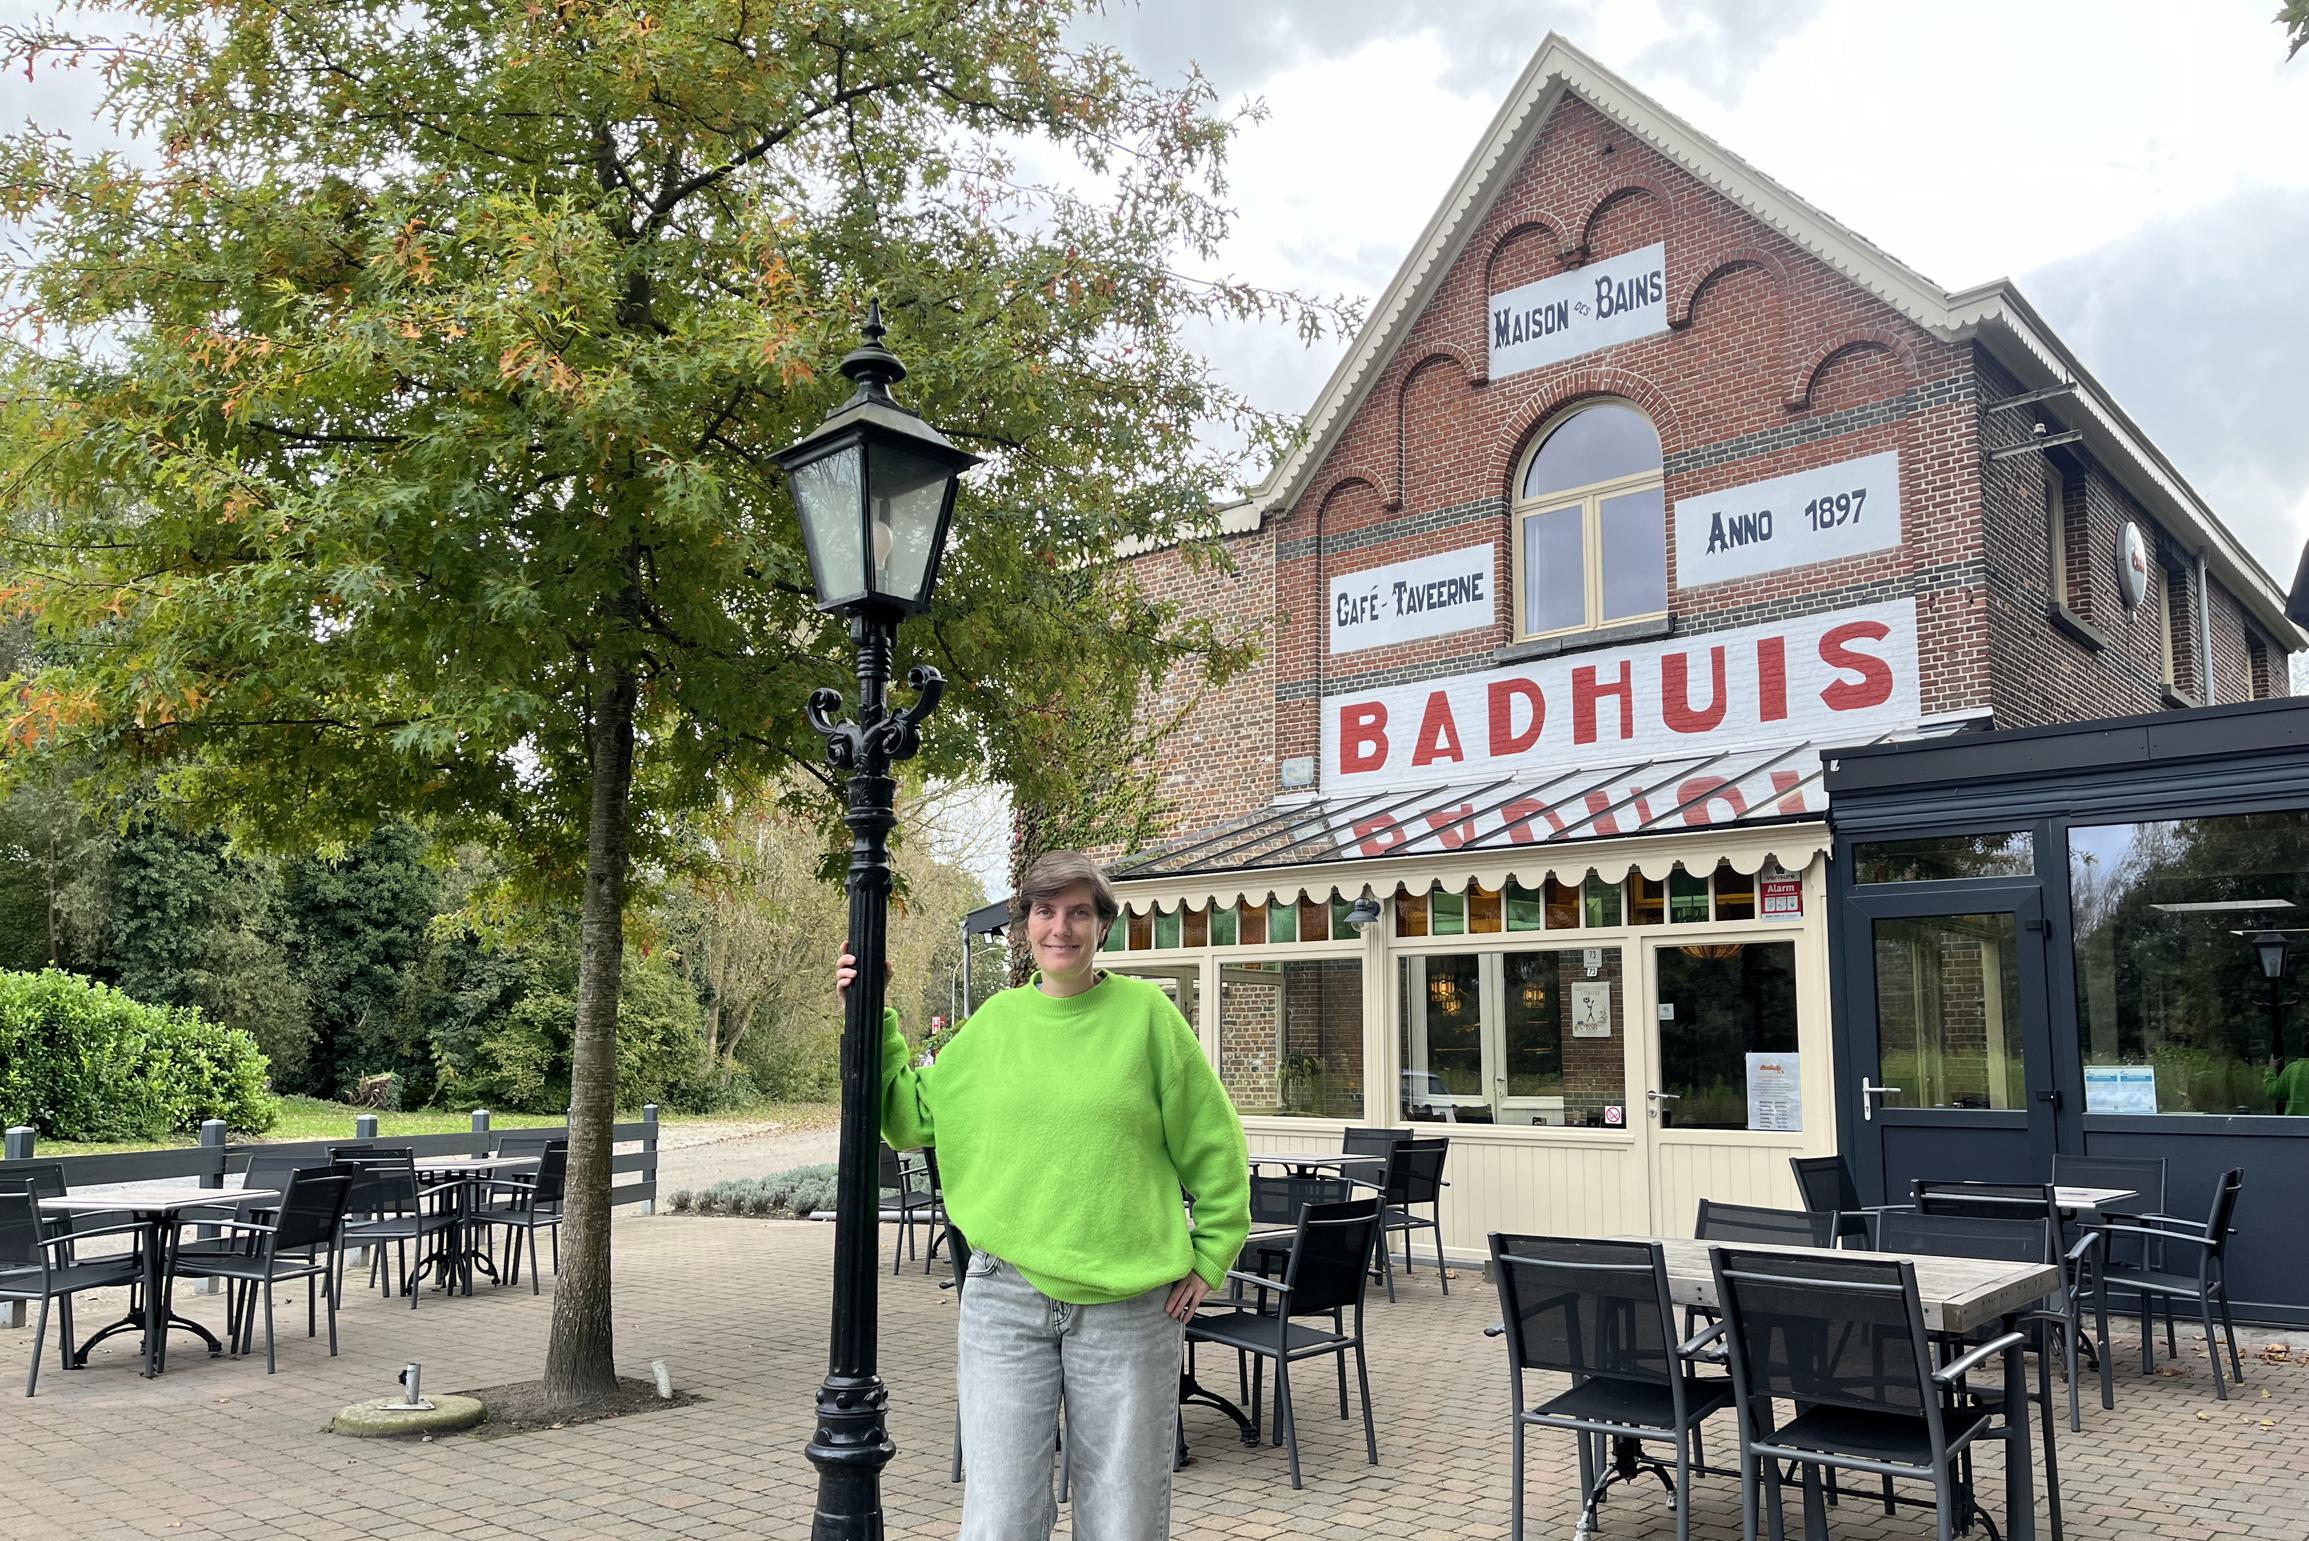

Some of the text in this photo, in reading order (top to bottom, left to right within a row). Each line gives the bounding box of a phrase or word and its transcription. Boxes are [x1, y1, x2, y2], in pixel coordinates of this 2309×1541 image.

[1494, 270, 1663, 350] MAISON DES BAINS
[1706, 488, 1867, 555] ANNO 1897
[1392, 572, 1484, 616] TAVEERNE
[1340, 620, 1893, 774] BADHUIS
[1767, 884, 1795, 893] Alarm
[1588, 950, 1597, 959] 73
[1588, 968, 1596, 976] 73
